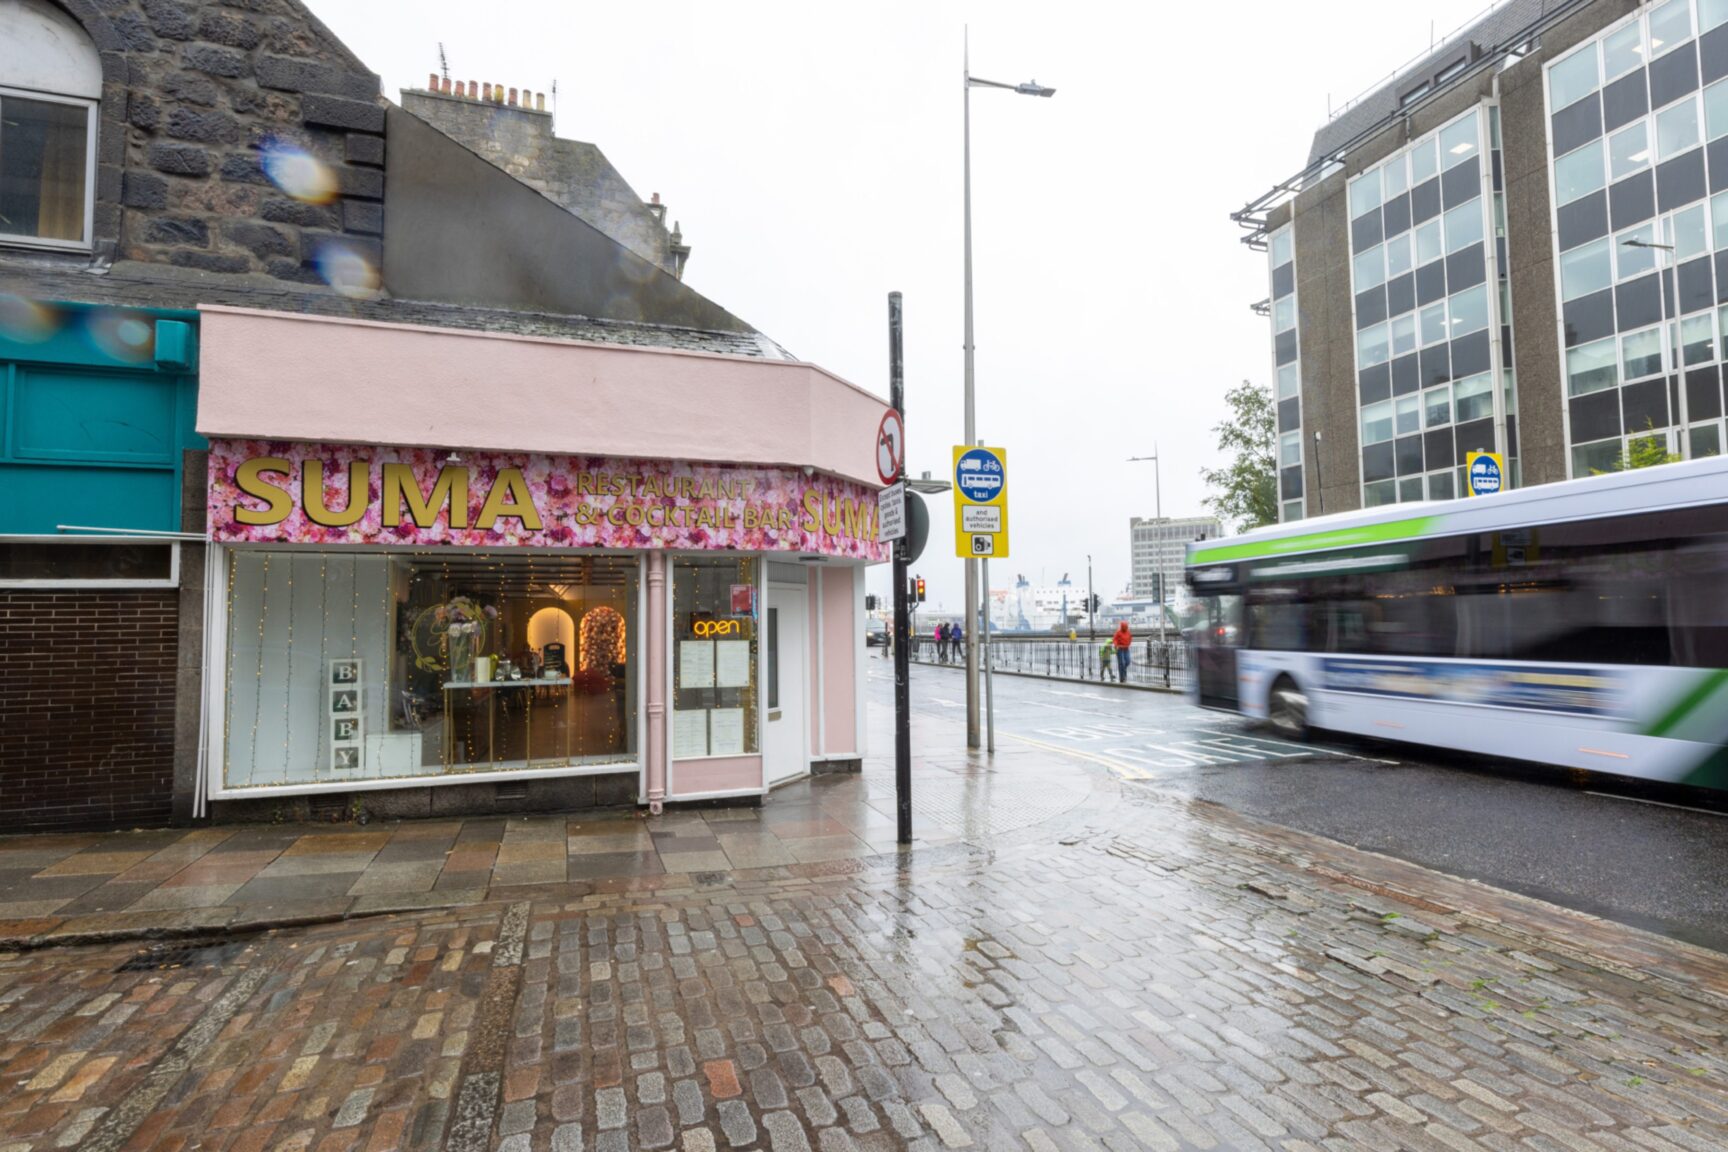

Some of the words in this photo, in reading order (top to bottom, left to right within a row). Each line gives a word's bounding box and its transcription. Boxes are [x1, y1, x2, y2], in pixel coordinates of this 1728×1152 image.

[233, 456, 544, 531] SUMA
[575, 472, 752, 501] RESTAURANT
[974, 490, 988, 498] taxi
[575, 502, 598, 526] &
[607, 503, 735, 529] COCKTAIL
[742, 508, 792, 530] BAR
[693, 619, 740, 638] open
[336, 665, 353, 765] BABY
[1033, 722, 1166, 742] BUS
[1104, 737, 1312, 767] GATE
